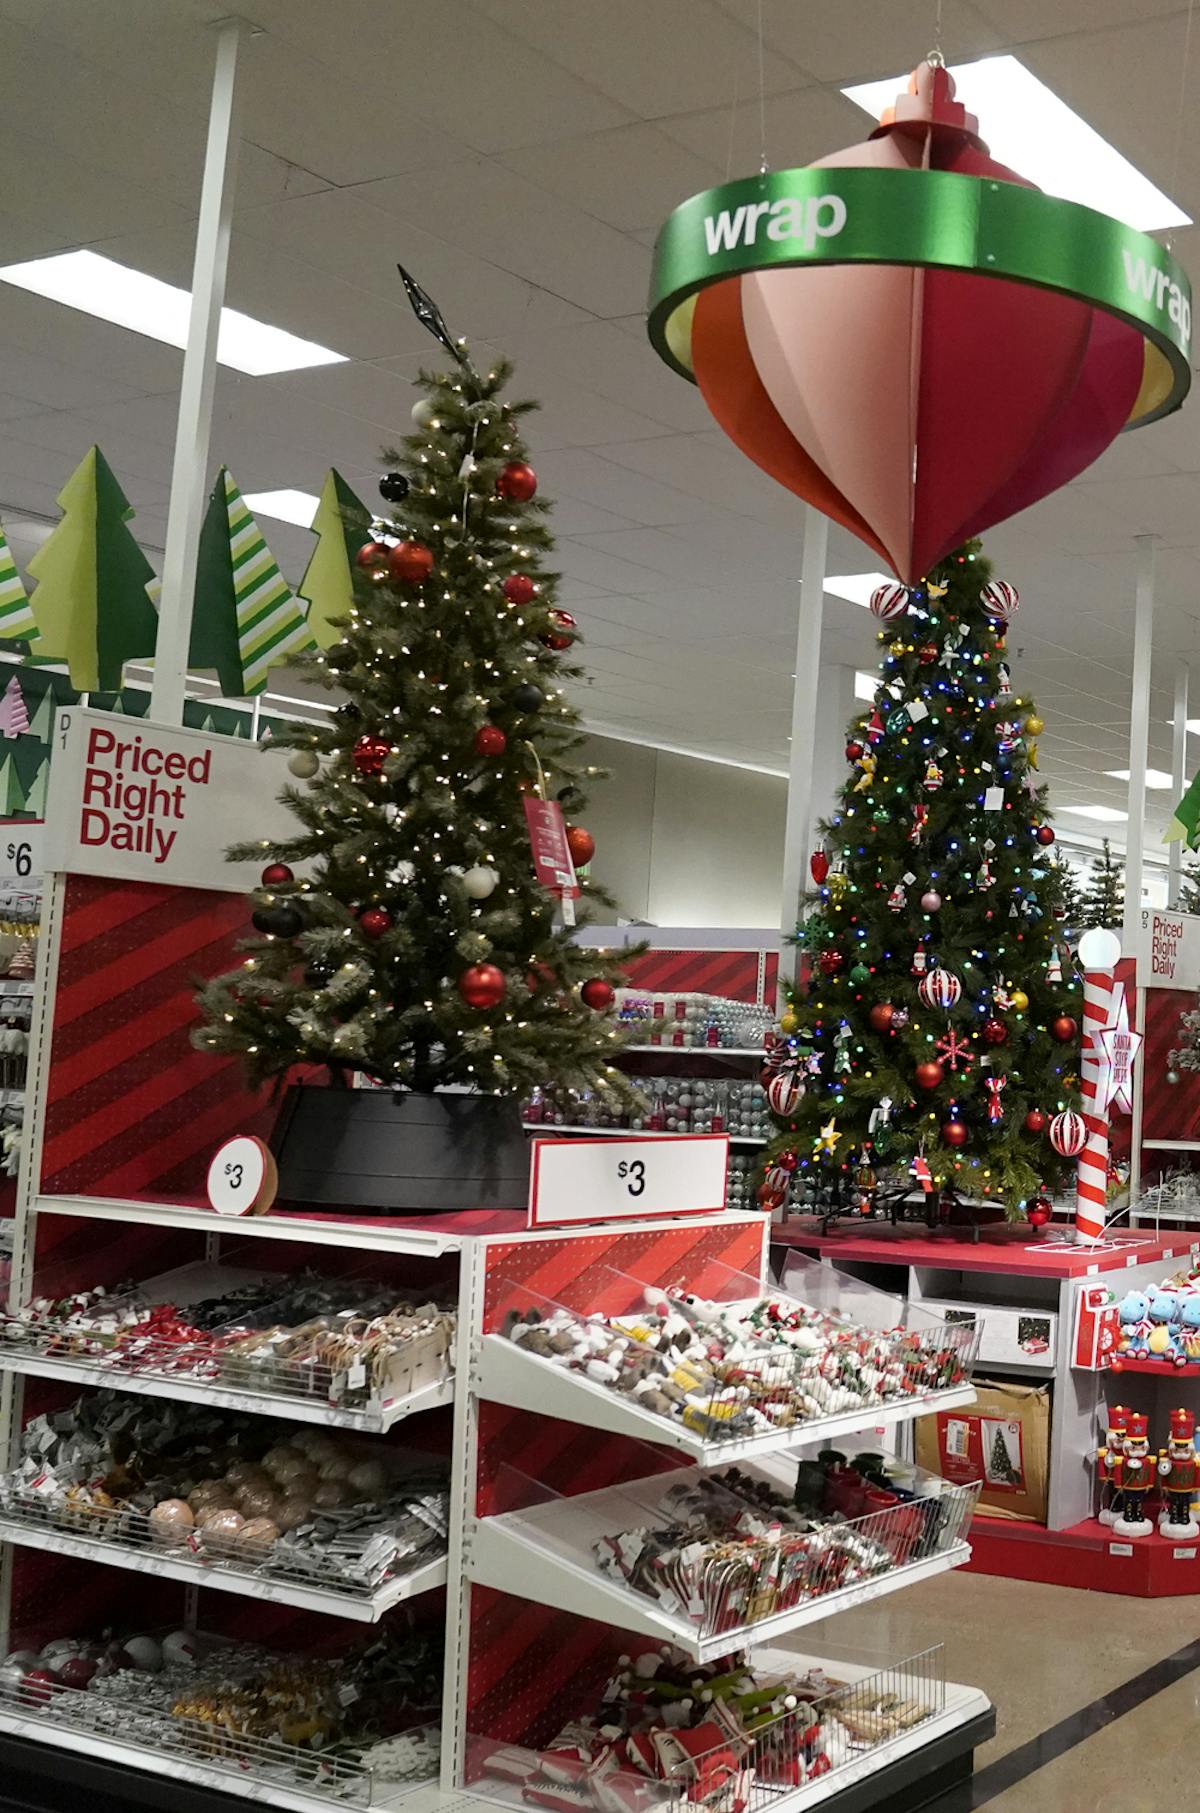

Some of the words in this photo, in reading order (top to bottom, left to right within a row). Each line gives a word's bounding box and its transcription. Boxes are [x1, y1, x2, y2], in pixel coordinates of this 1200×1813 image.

[704, 194, 847, 256] wrap
[1121, 249, 1191, 345] wrap
[87, 728, 212, 784] Priced
[83, 768, 186, 821] Right
[80, 808, 177, 864] Daily
[7, 843, 32, 876] $6
[1152, 917, 1183, 939] Priced
[1152, 936, 1177, 960] Right
[1152, 956, 1176, 980] Daily
[1113, 1034, 1131, 1049] SANTA
[224, 1163, 243, 1189] $3
[617, 1160, 645, 1196] $3
